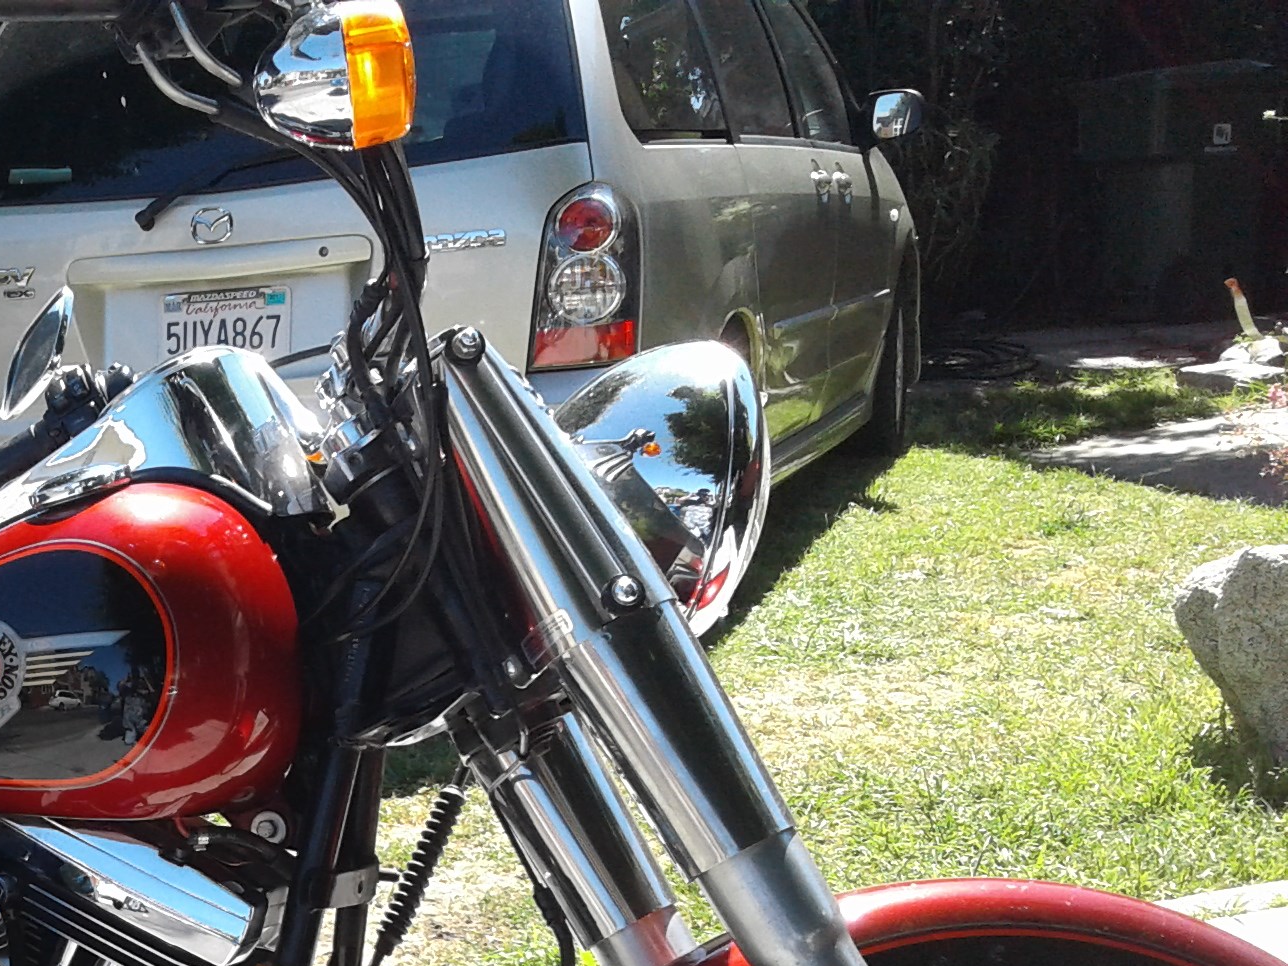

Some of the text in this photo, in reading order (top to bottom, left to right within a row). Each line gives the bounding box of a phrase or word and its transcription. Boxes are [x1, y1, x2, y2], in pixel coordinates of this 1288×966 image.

[190, 290, 257, 302] MAZDASPEED
[185, 300, 265, 318] California
[166, 314, 281, 355] 5UYA867
